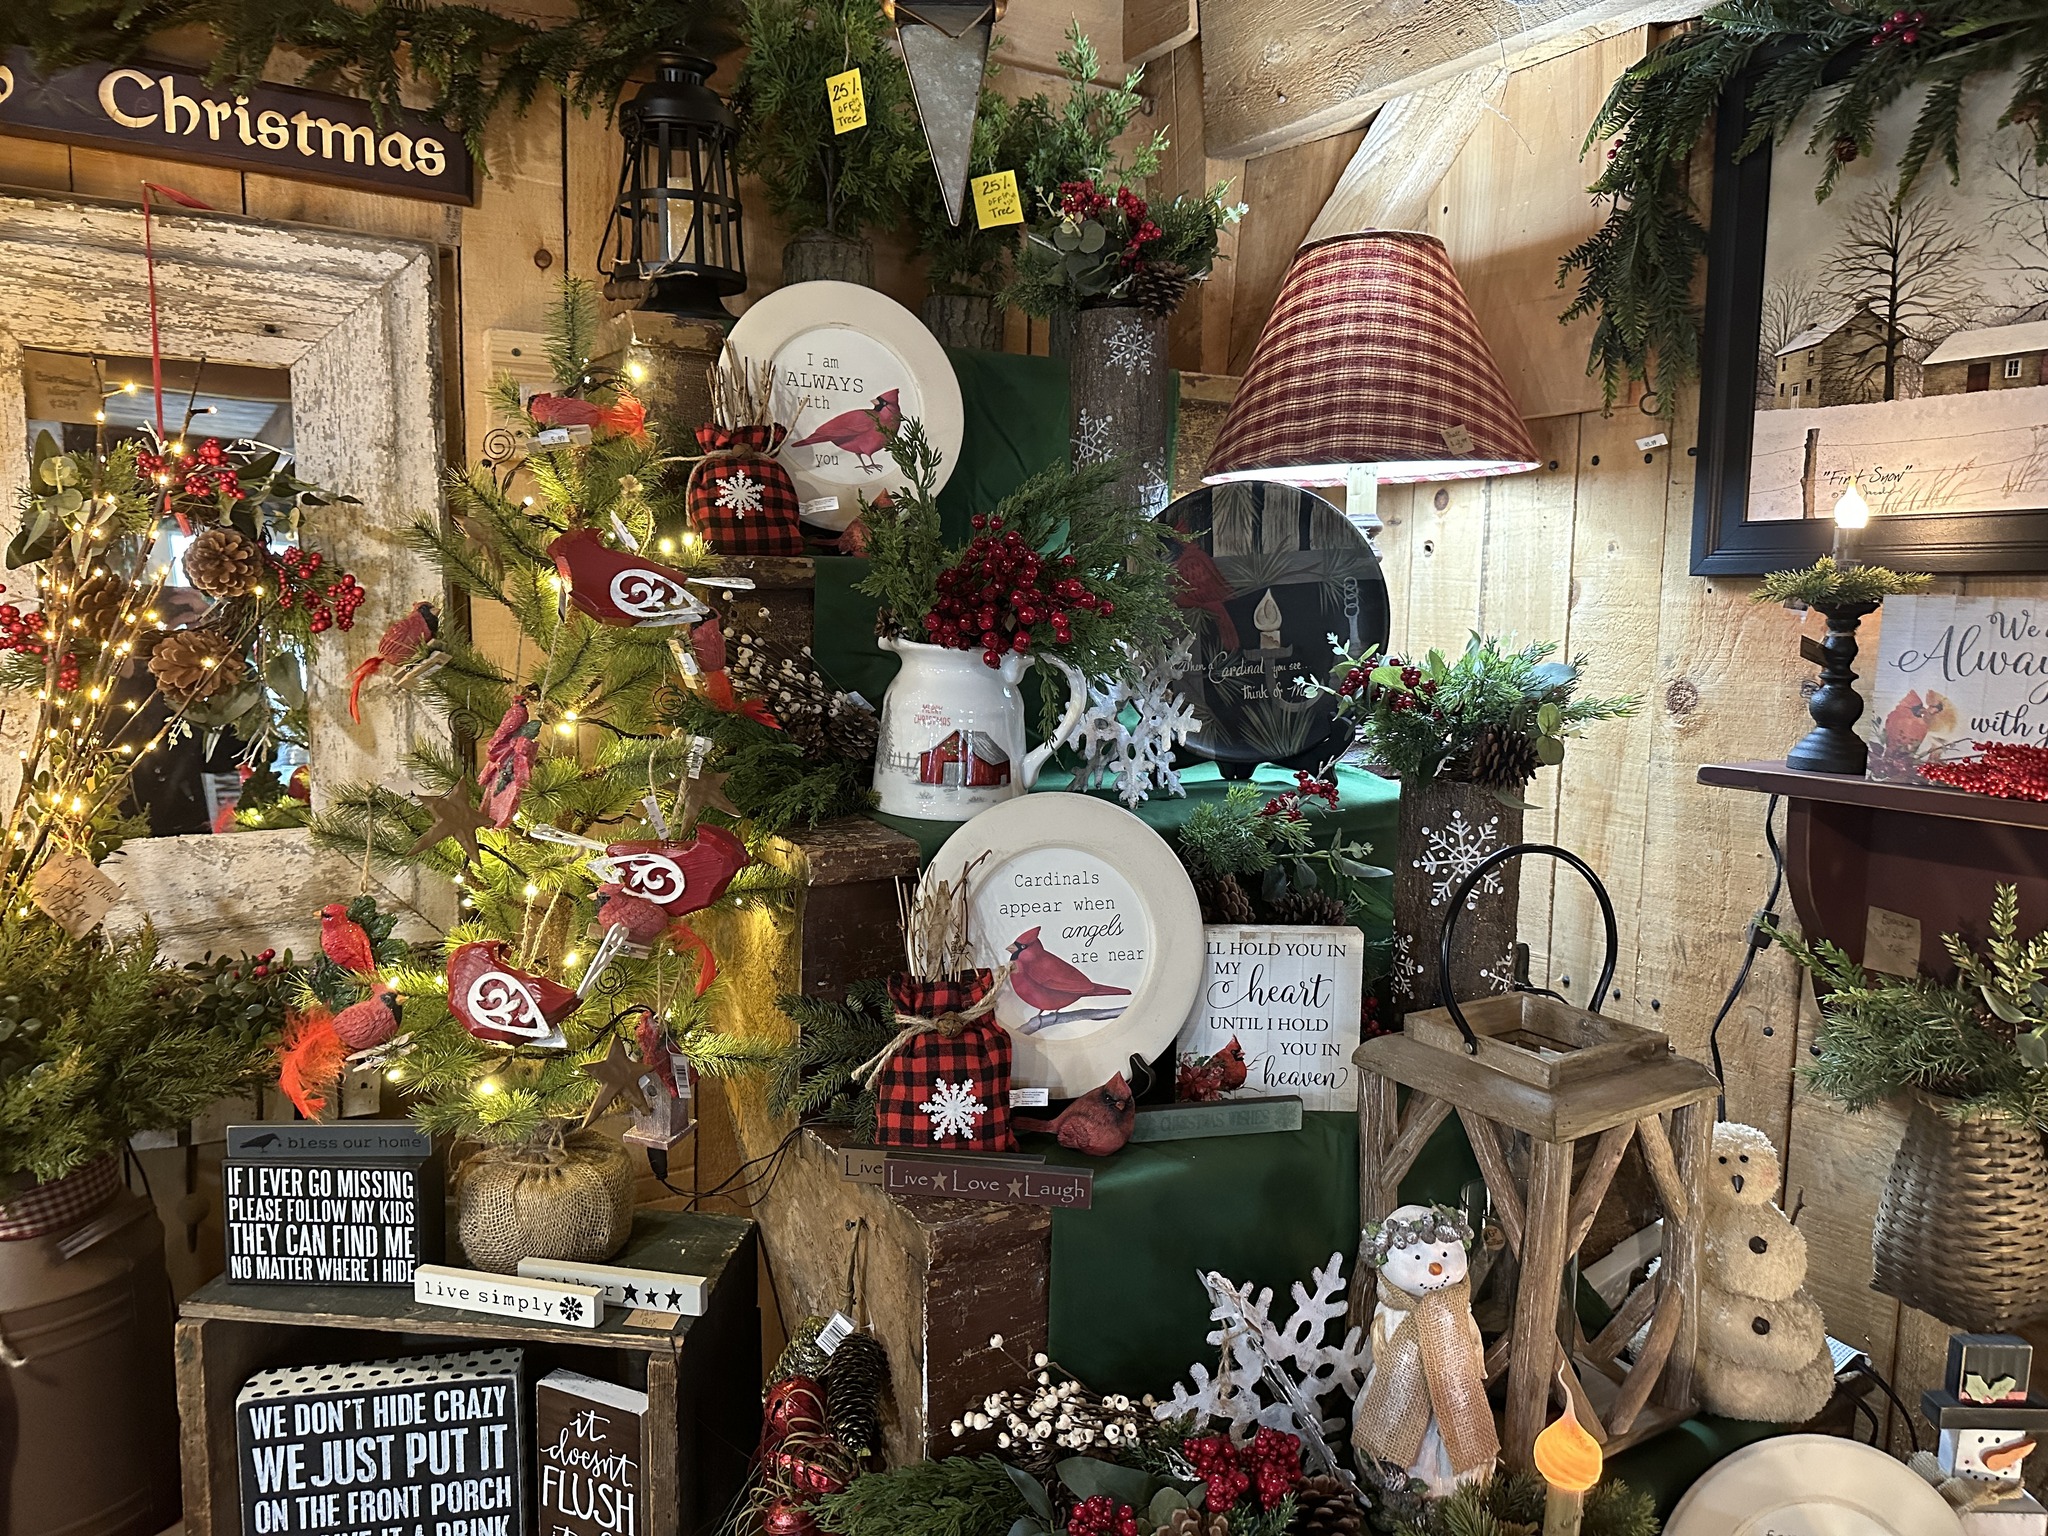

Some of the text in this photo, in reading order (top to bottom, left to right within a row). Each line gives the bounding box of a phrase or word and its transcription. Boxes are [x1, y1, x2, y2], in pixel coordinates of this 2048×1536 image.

[98, 69, 446, 176] Christmas
[836, 113, 862, 126] Tree
[989, 206, 1015, 218] Tree
[807, 353, 839, 369] I am
[786, 371, 864, 393] ALWAYS
[815, 453, 839, 468] you
[1987, 609, 2041, 641] We
[1208, 651, 1265, 684] Cardinal
[1272, 664, 1286, 679] you
[1241, 684, 1269, 700] think
[1272, 681, 1283, 700] of
[913, 714, 952, 727] CHRISTMAS
[1971, 704, 2033, 737] with
[1014, 870, 1100, 888] Cardinals
[999, 896, 1116, 918] appear when
[1061, 913, 1125, 948] angels
[1071, 949, 1145, 964] are near
[1230, 942, 1281, 956] HOLD
[1285, 943, 1323, 957] YOU
[1327, 944, 1347, 957] IN
[1214, 962, 1242, 975] MY
[1206, 963, 1334, 1010] heart
[1210, 1016, 1329, 1032] UNTIL I HOLD
[1280, 1042, 1341, 1057] YOU IN
[1263, 1054, 1349, 1090] heaven
[288, 1137, 422, 1149] bless our home
[845, 1155, 883, 1177] Live
[227, 1167, 414, 1199] IF I EVER GO MISSING
[890, 1165, 1085, 1203] Live Love Laugh
[229, 1198, 415, 1225] PLEASE FOLLOW MY KIDS
[230, 1223, 416, 1259] THEY CAN FIND ME
[231, 1256, 416, 1283] NO MATTER WHERE I HIDE
[424, 1281, 553, 1317] live simply
[249, 1385, 507, 1440] WE DON'T HIDE CRAZY
[569, 1409, 611, 1442] it
[251, 1423, 508, 1494] WE JUST PUT IT
[254, 1475, 512, 1534] ON THE FRONT PORCH
[542, 1464, 635, 1536] FLUSH
